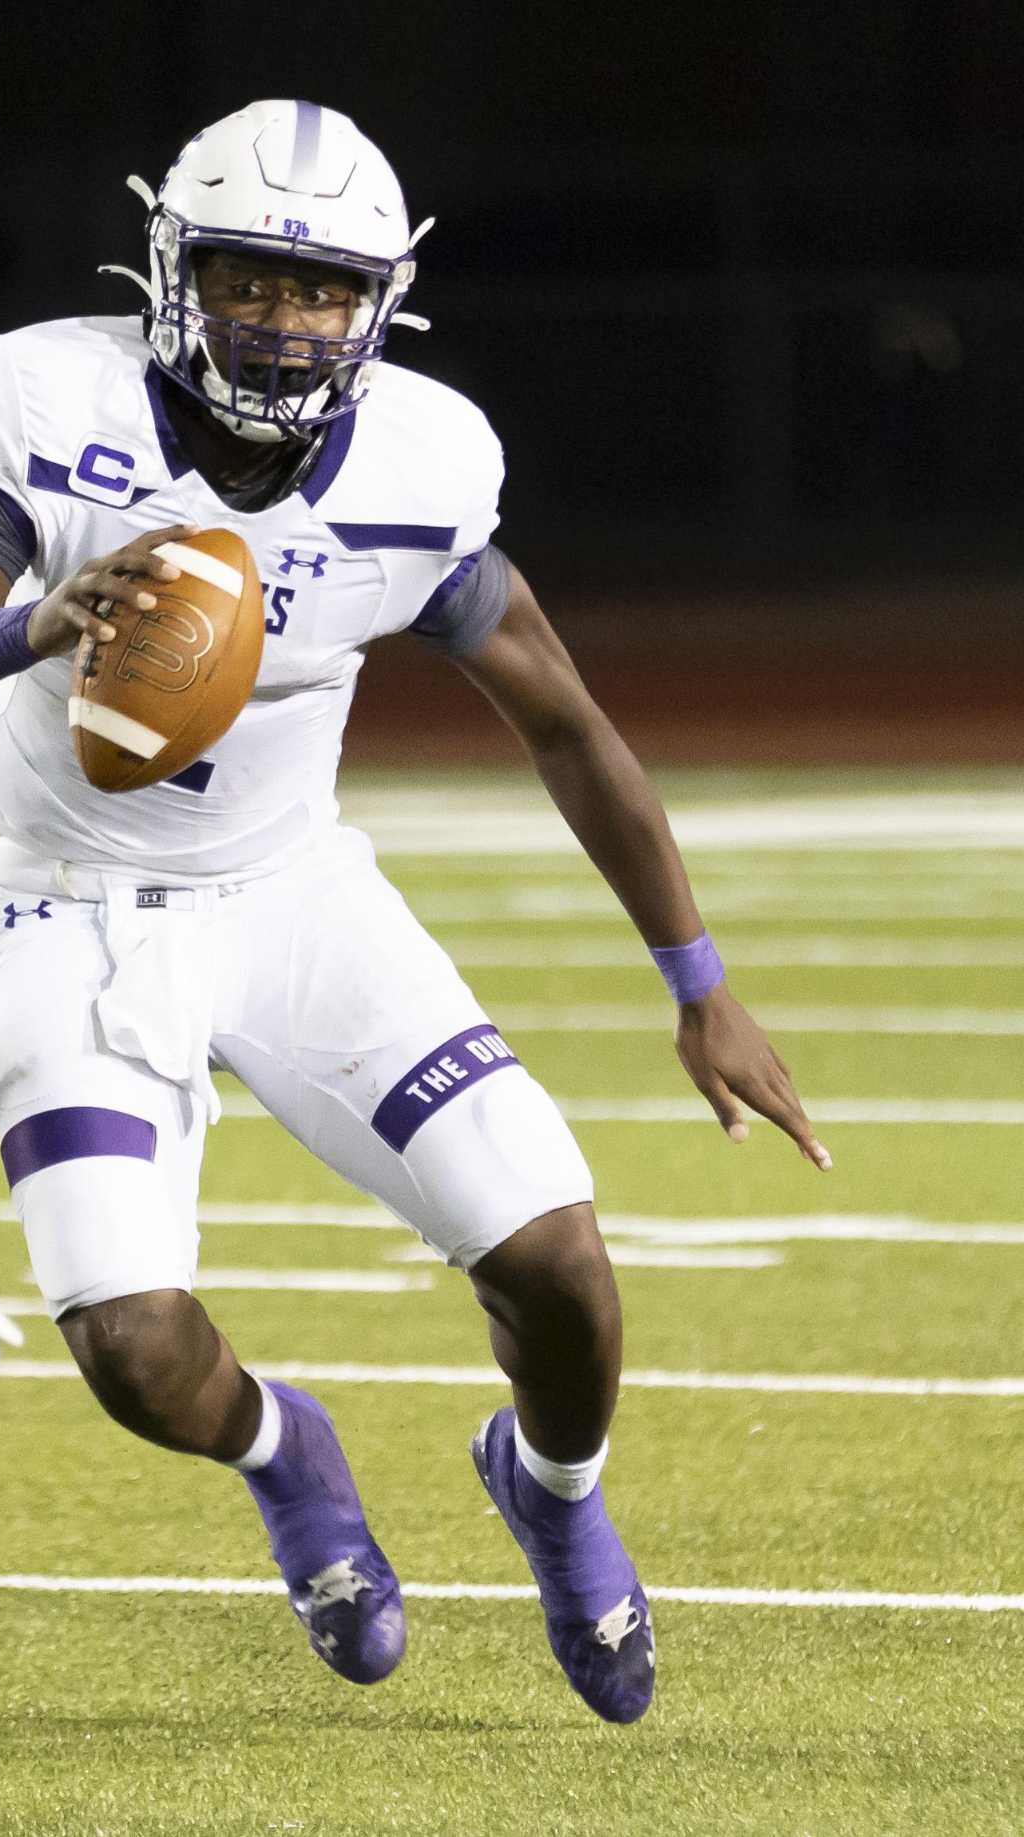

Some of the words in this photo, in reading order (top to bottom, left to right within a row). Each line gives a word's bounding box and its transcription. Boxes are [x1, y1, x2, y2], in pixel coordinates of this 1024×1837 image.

[76, 443, 135, 493] C
[260, 582, 296, 636] S
[405, 1055, 469, 1104] THE
